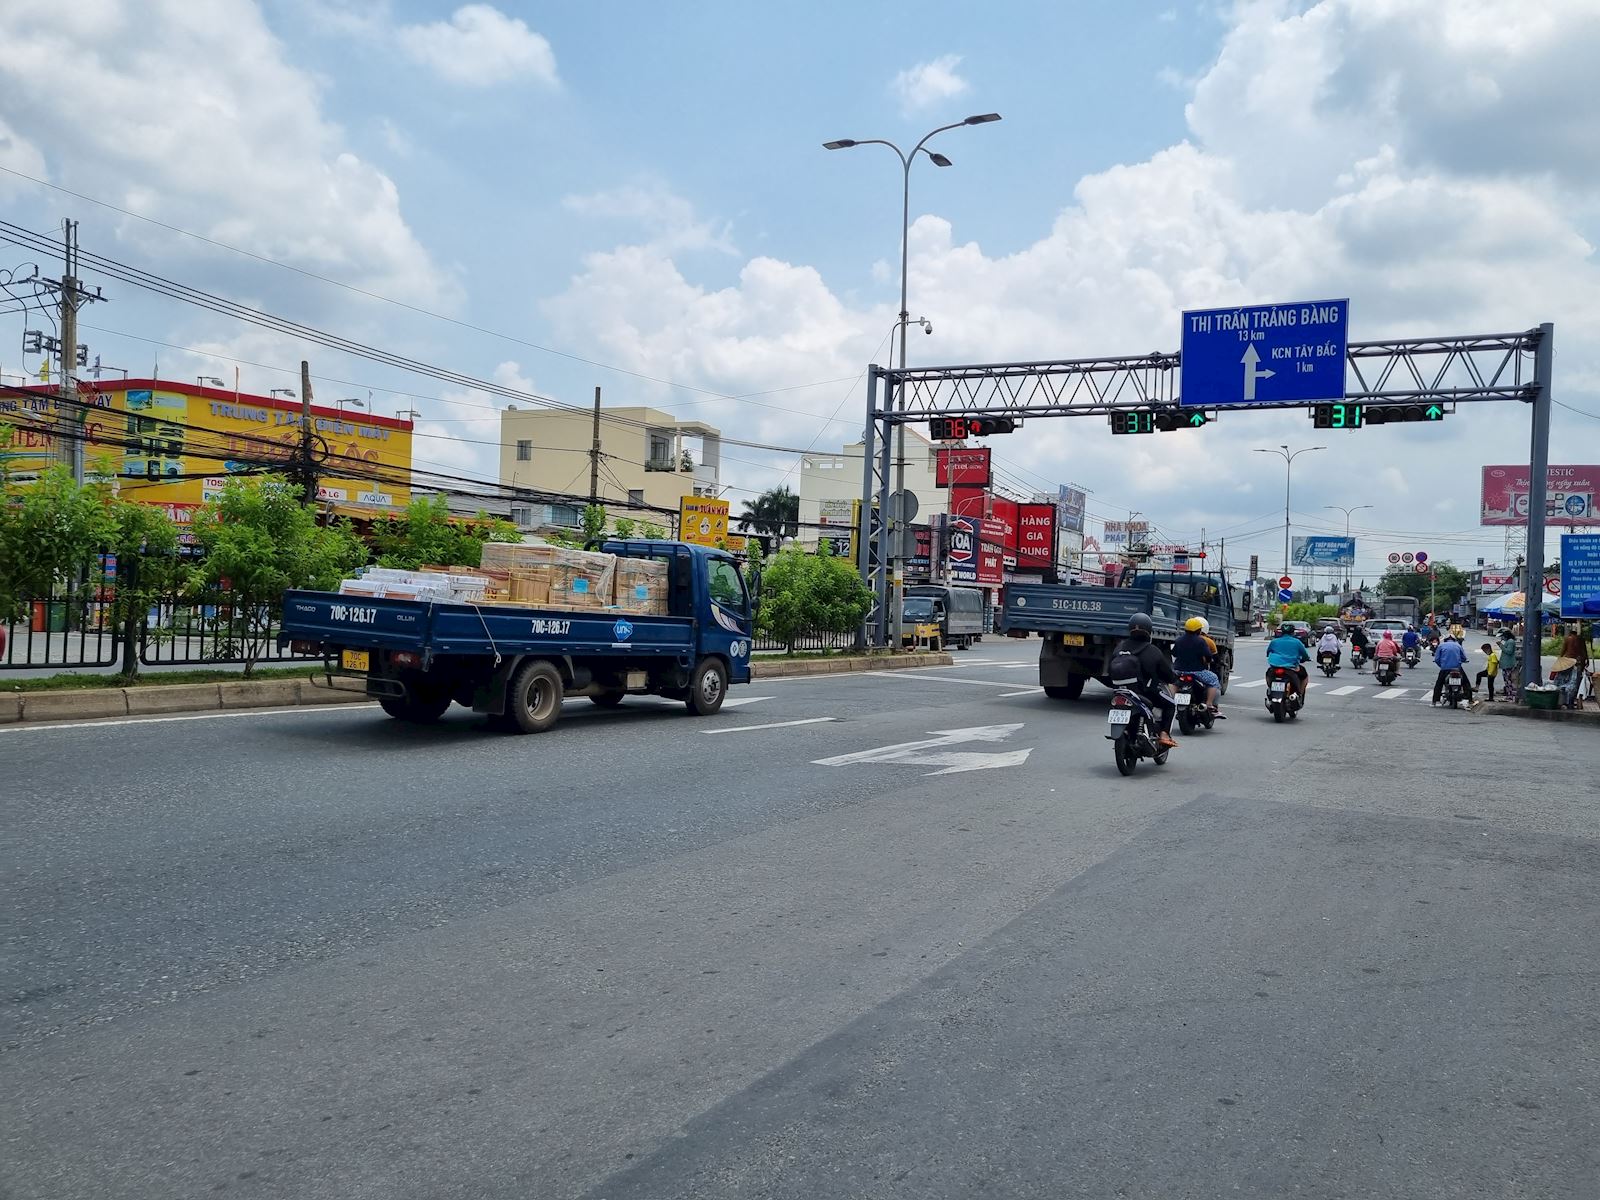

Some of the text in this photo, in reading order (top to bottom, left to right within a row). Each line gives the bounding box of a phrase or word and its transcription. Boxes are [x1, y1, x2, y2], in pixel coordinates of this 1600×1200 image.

[1191, 304, 1339, 334] THỊ TRẤN TRẢNG BÀNG
[1238, 329, 1265, 342] 13 km
[1271, 340, 1337, 360] KCN TÂY BẮC
[1296, 361, 1314, 373] 1 km
[209, 401, 267, 423] TRUNG
[1332, 404, 1360, 428] 31
[1127, 412, 1151, 433] 31
[328, 491, 340, 499] LG
[363, 494, 386, 503] AQUA
[1021, 515, 1050, 526] HÀNG
[838, 542, 850, 553] 12
[984, 556, 997, 568] PHÁT
[958, 571, 977, 580] WORLD
[1052, 599, 1102, 611] 51C-116.38
[330, 605, 377, 624] 70C-126.17
[531, 619, 570, 634] 70C-126.17
